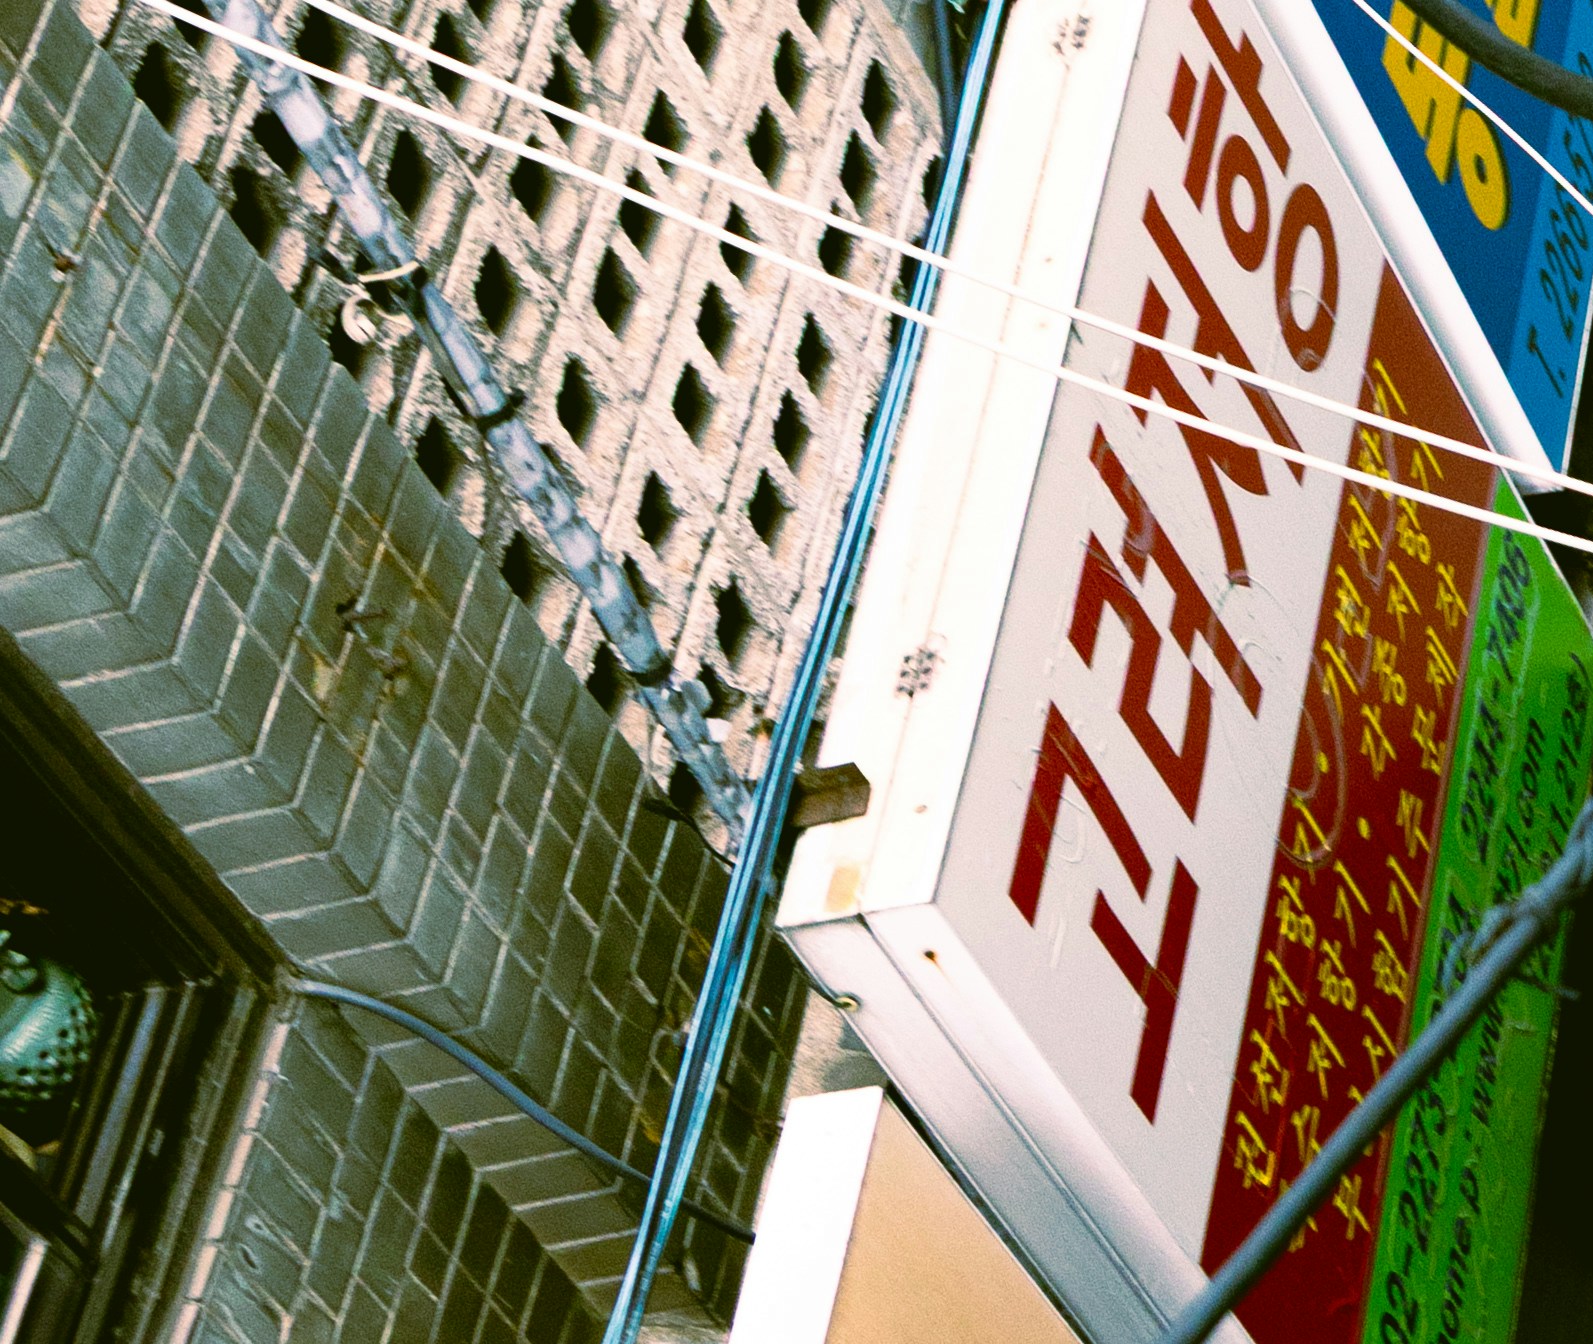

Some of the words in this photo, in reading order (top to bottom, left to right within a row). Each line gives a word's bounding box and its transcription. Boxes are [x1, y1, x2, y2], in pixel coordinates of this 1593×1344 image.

[1527, 325, 1565, 398] T.
[1006, 0, 1338, 1122] 고려저항
[1361, 441, 1445, 778] 각종저항기
